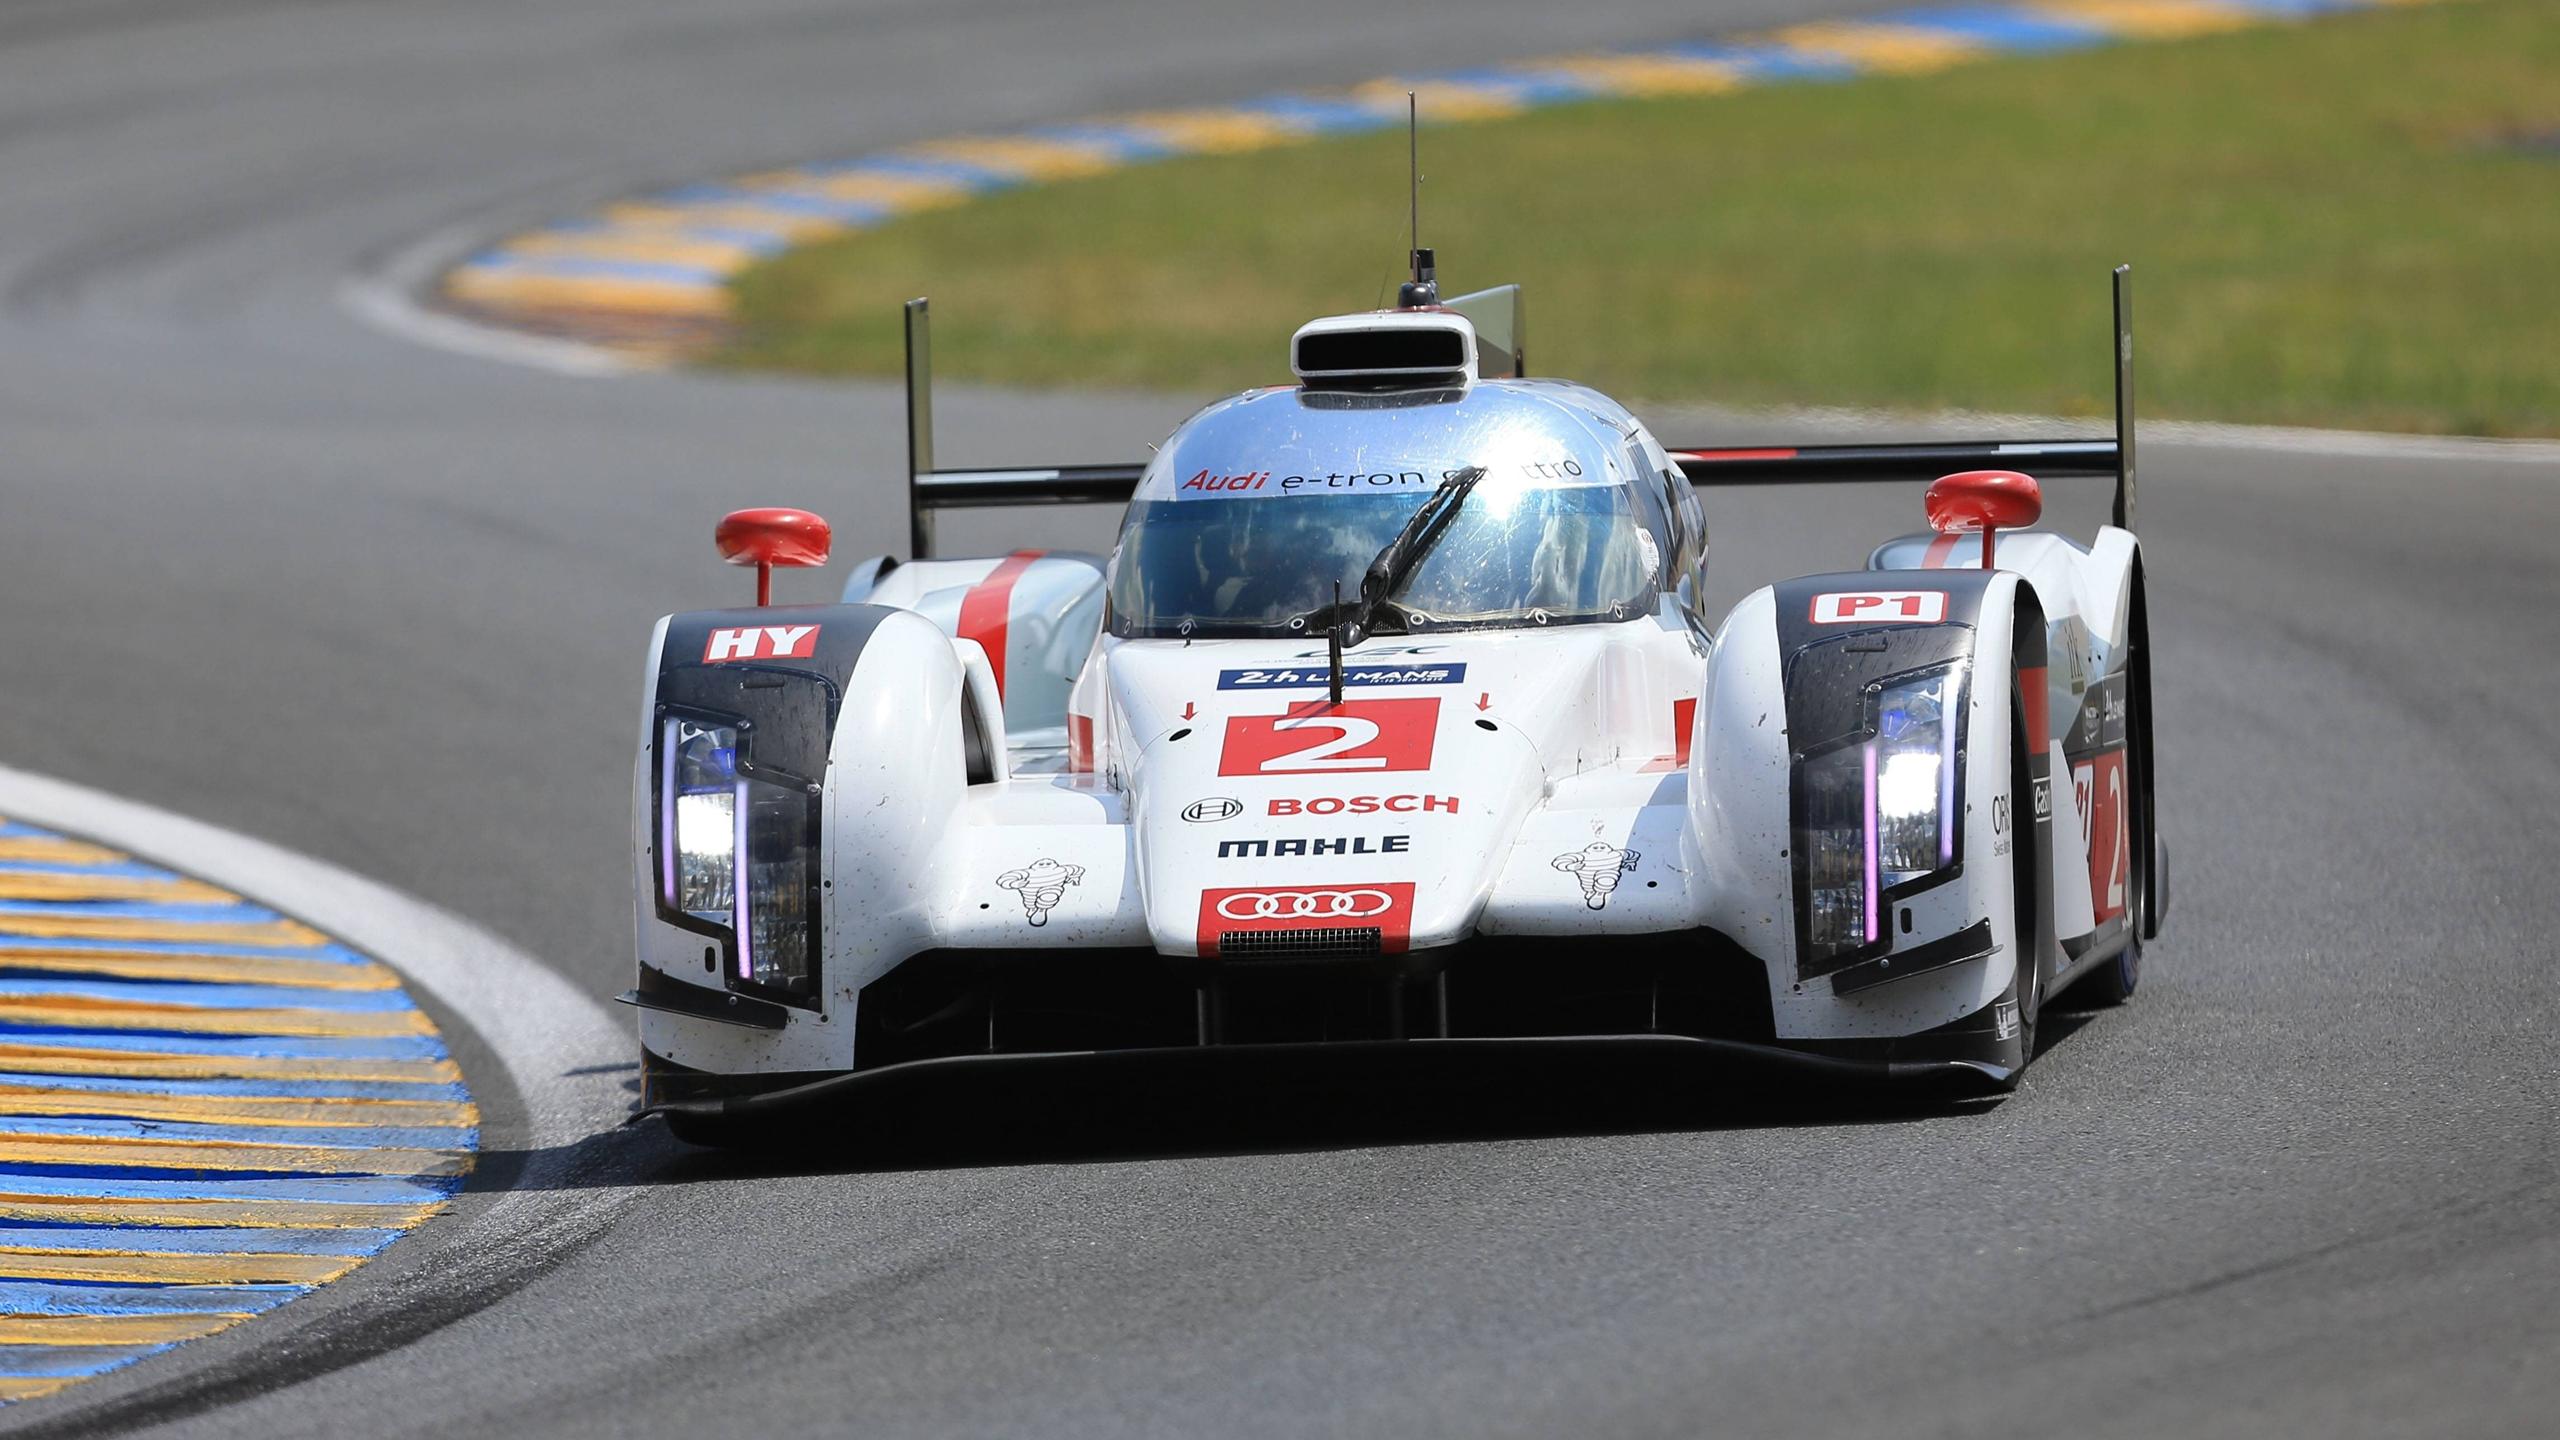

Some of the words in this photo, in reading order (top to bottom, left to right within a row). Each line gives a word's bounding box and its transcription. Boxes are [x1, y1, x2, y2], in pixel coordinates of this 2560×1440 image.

[1181, 469, 1270, 491] Audi
[1280, 470, 1425, 489] e-tron
[1836, 595, 1922, 617] P1
[708, 626, 817, 660] HY
[1352, 670, 1450, 681] MANS
[1259, 716, 1389, 772] 2
[1267, 795, 1460, 816] BOSCH
[1217, 835, 1411, 858] MAHLE
[2107, 765, 2123, 909] 2
